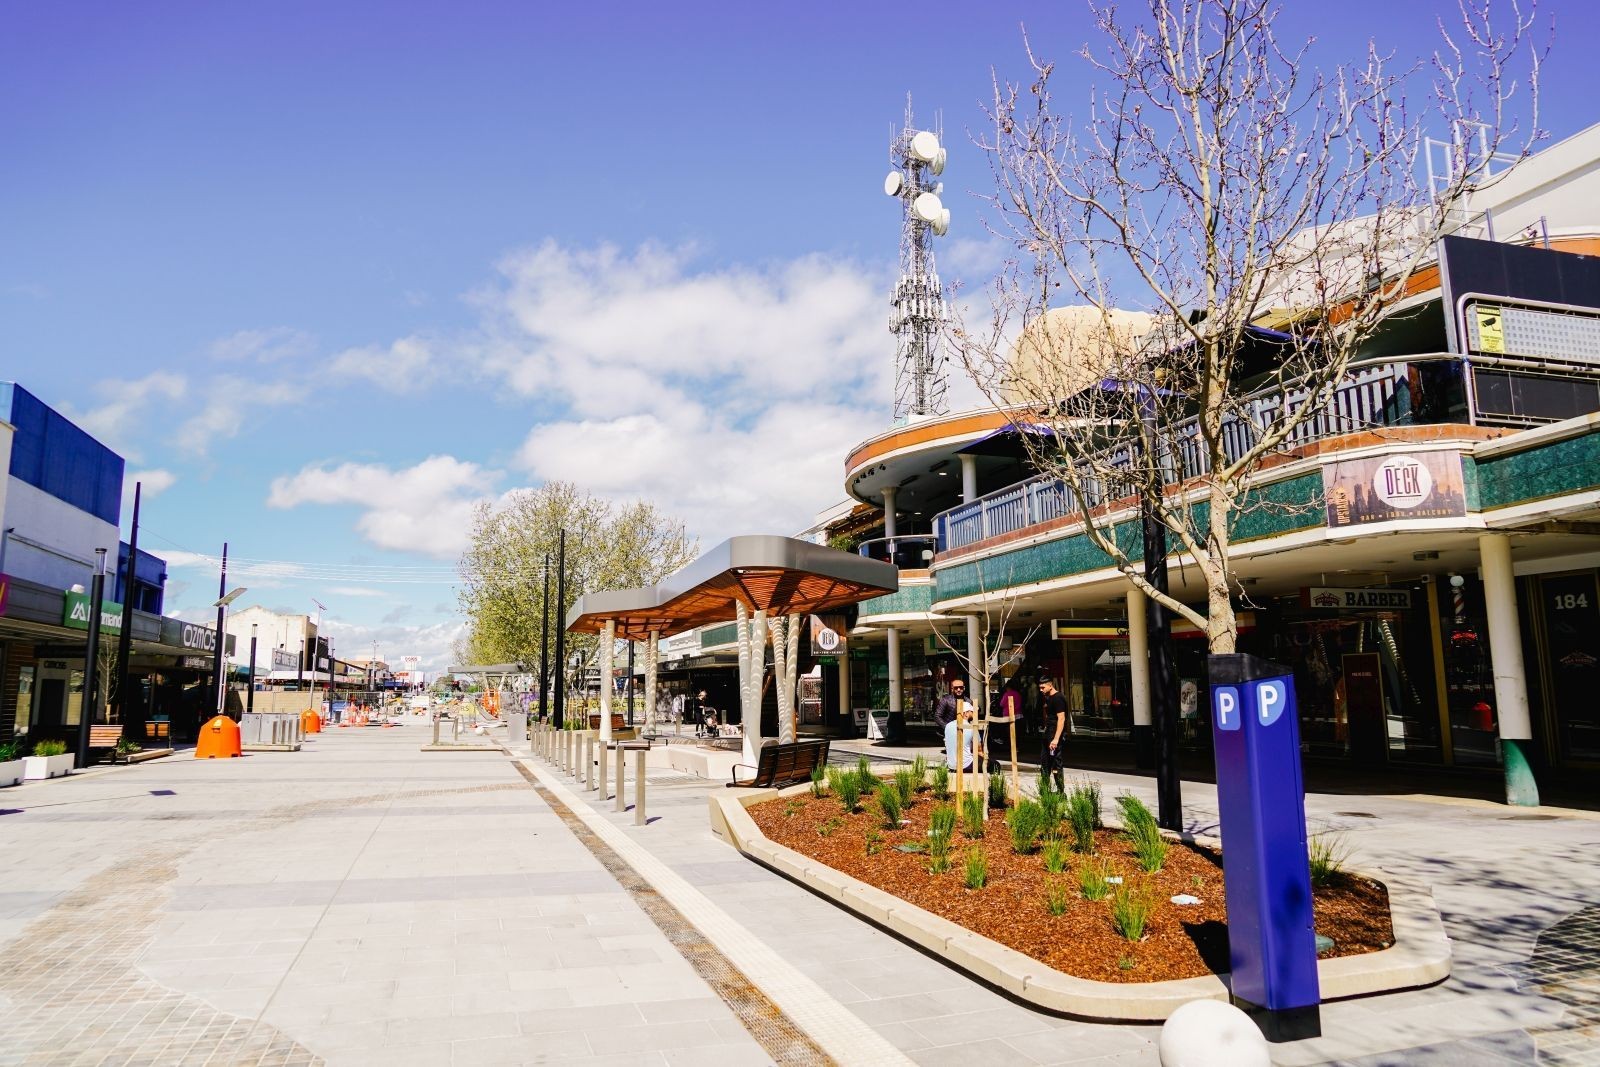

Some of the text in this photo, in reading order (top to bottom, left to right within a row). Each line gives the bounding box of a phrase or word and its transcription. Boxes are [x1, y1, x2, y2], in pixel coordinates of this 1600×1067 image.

[1385, 467, 1420, 496] DECK
[1345, 591, 1409, 607] BARBER
[1554, 593, 1588, 609] 184
[1219, 692, 1235, 725] P
[1260, 684, 1278, 718] P
